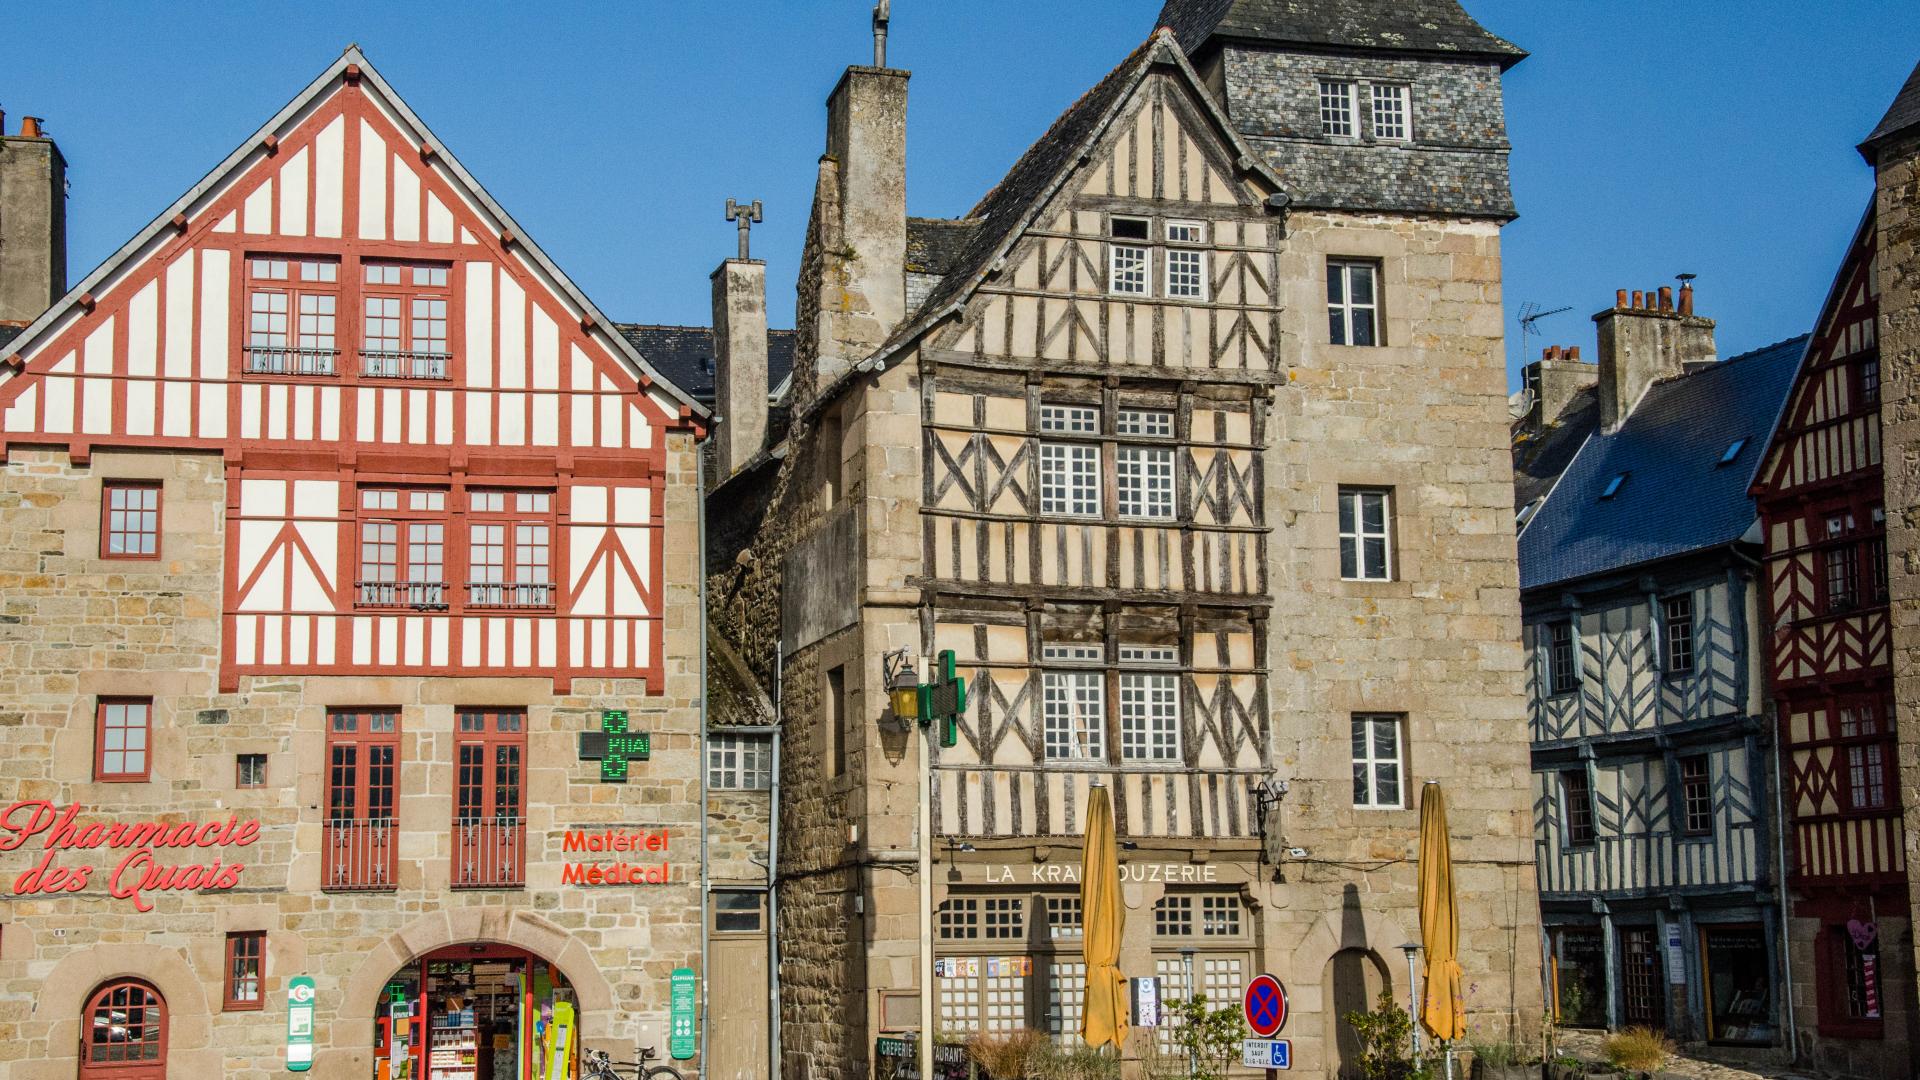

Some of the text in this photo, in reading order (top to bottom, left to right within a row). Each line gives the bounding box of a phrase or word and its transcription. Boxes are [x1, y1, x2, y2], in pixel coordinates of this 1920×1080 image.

[0, 800, 261, 850] Pharmacie
[562, 828, 669, 852] Matériel
[13, 847, 245, 913] des Quais
[561, 861, 669, 885] Médical
[985, 864, 1217, 883] LA KRAOUZERIE
